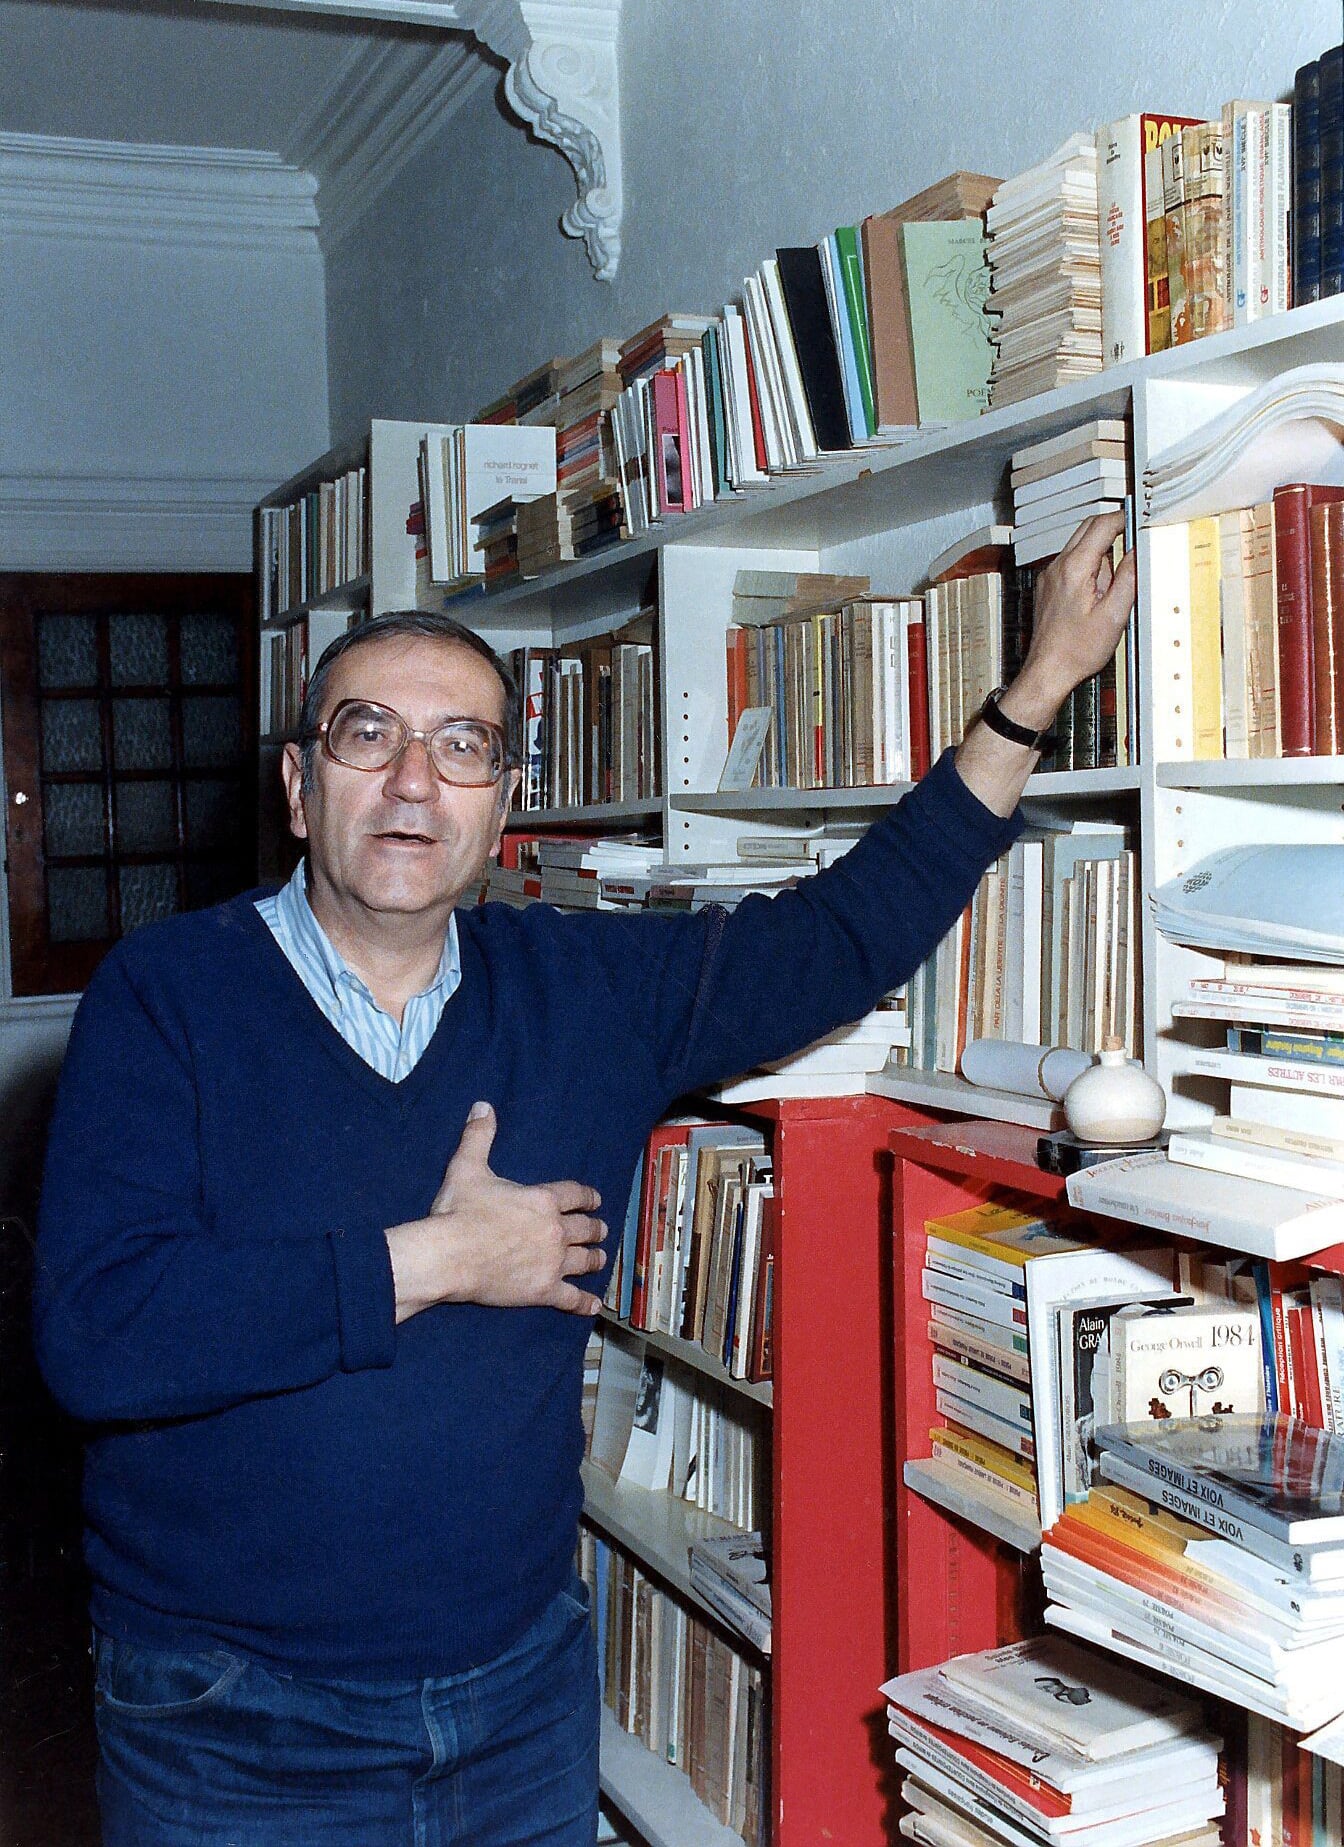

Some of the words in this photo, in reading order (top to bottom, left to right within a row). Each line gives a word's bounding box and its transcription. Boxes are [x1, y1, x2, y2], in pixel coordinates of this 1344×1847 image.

[1268, 1067, 1304, 1080] AUTRES
[1079, 1318, 1104, 1332] Alain
[1130, 1339, 1168, 1352] George
[1168, 1336, 1203, 1349] Orwell
[1210, 1324, 1255, 1348] 1984
[1276, 1342, 1285, 1384] Réception
[1148, 1458, 1184, 1487] IMAGES
[1187, 1481, 1198, 1493] ET
[1162, 1490, 1200, 1518] IMAGES
[1200, 1488, 1224, 1507] VOIX
[1204, 1513, 1215, 1526] ET
[1218, 1517, 1244, 1540] VOIX
